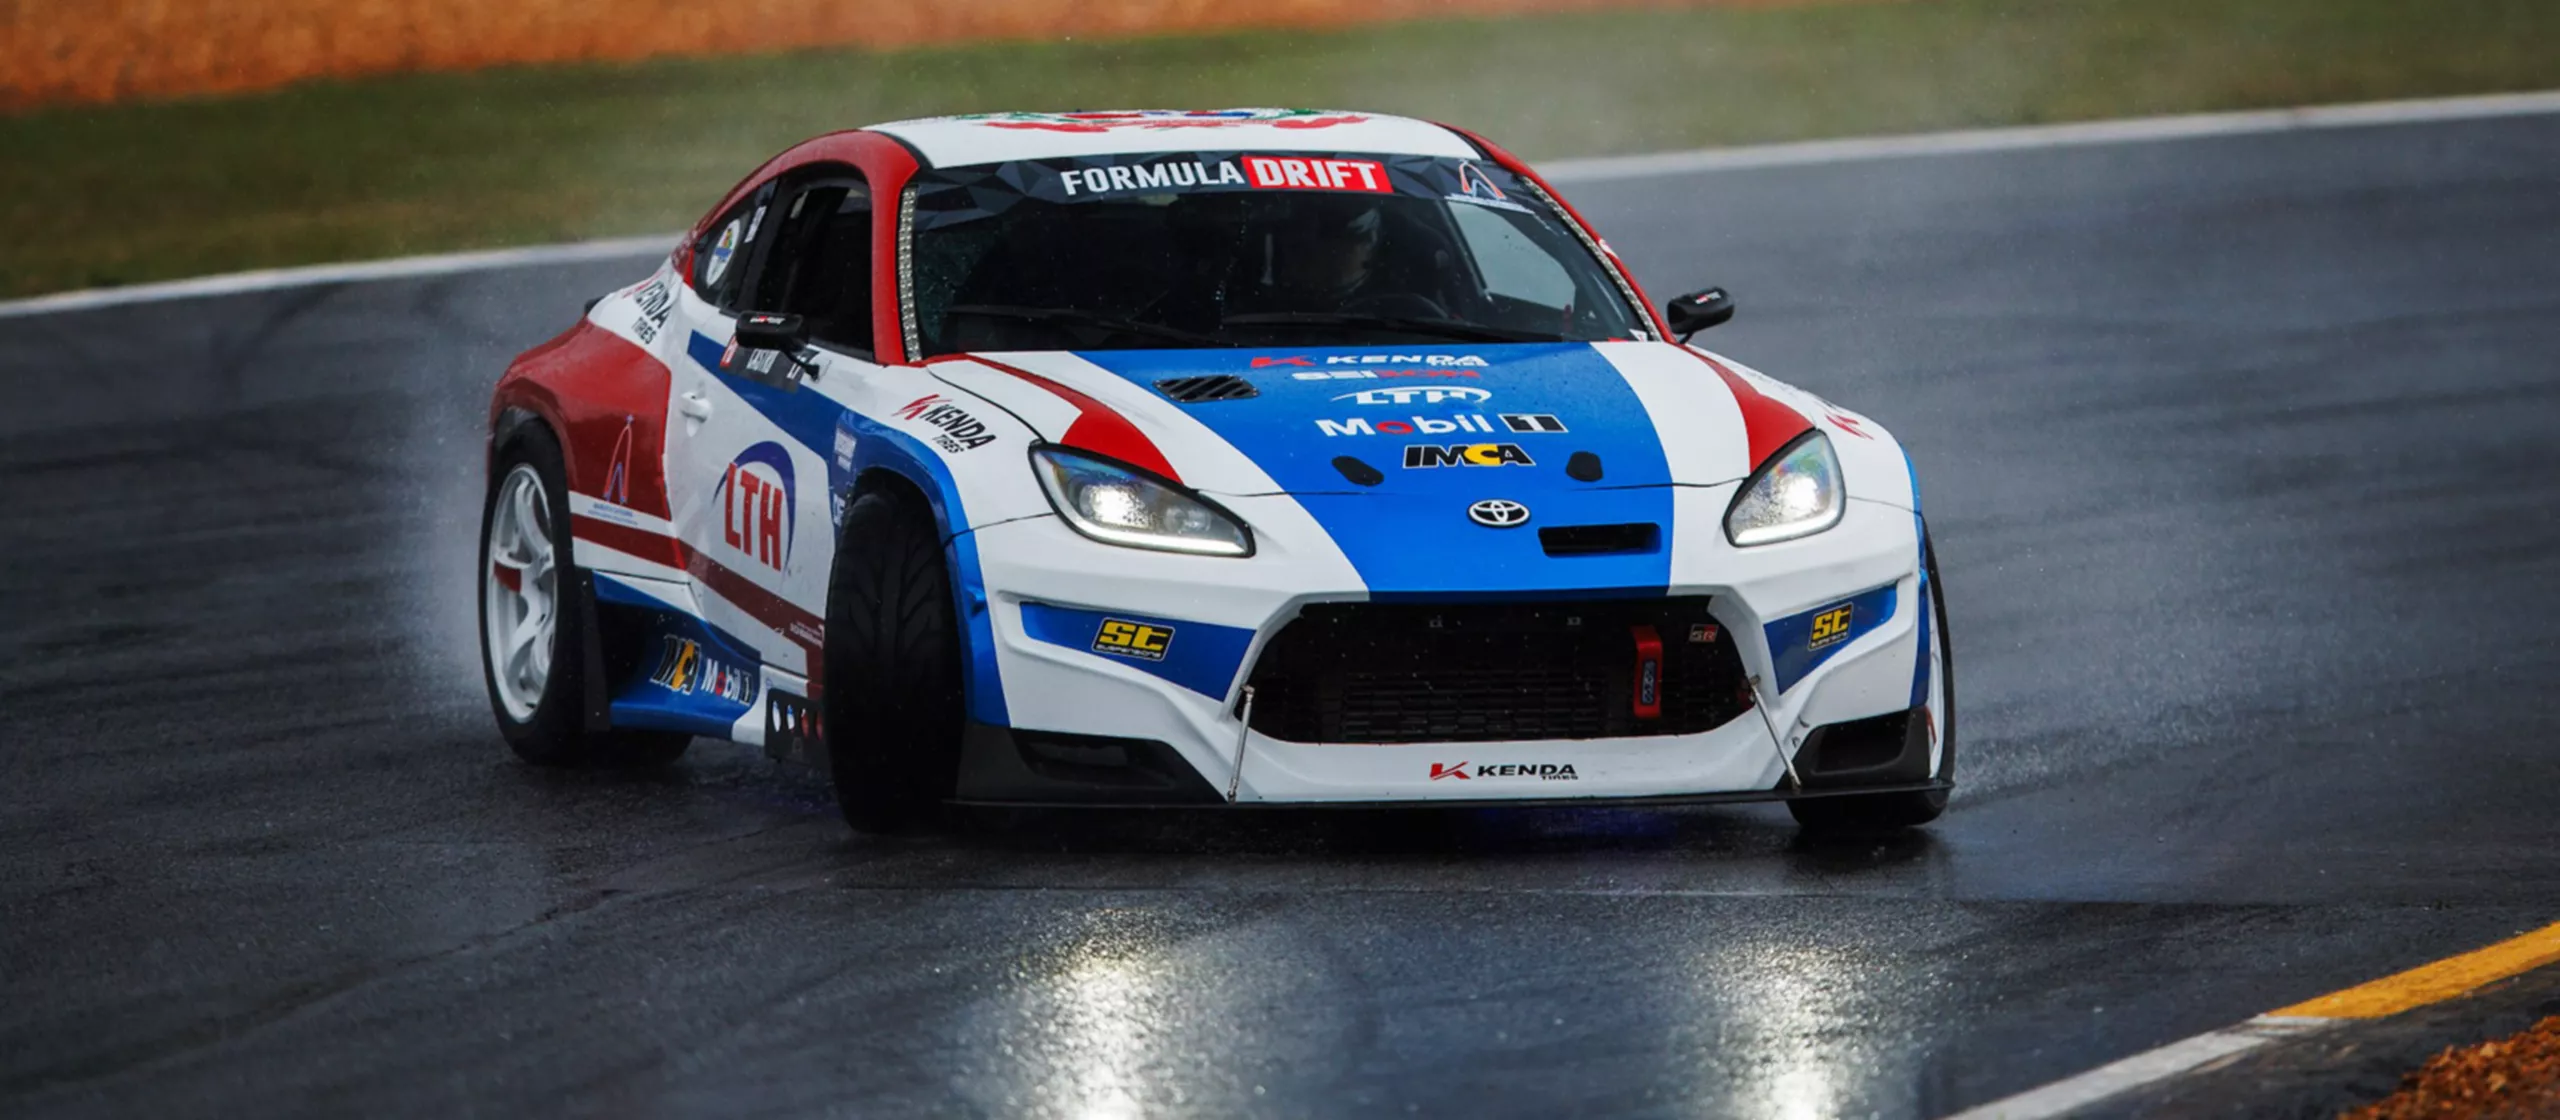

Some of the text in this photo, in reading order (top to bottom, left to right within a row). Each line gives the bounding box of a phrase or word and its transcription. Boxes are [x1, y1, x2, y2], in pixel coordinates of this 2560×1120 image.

[1060, 158, 1378, 195] FORMULA DRIFT
[1326, 355, 1490, 367] KENDA
[919, 404, 997, 450] KENDA
[1314, 414, 1496, 437] Mobil
[1402, 443, 1537, 469] IMCA
[724, 461, 784, 573] LTH
[700, 658, 742, 702] Mobil
[1477, 763, 1577, 777] KENDA
